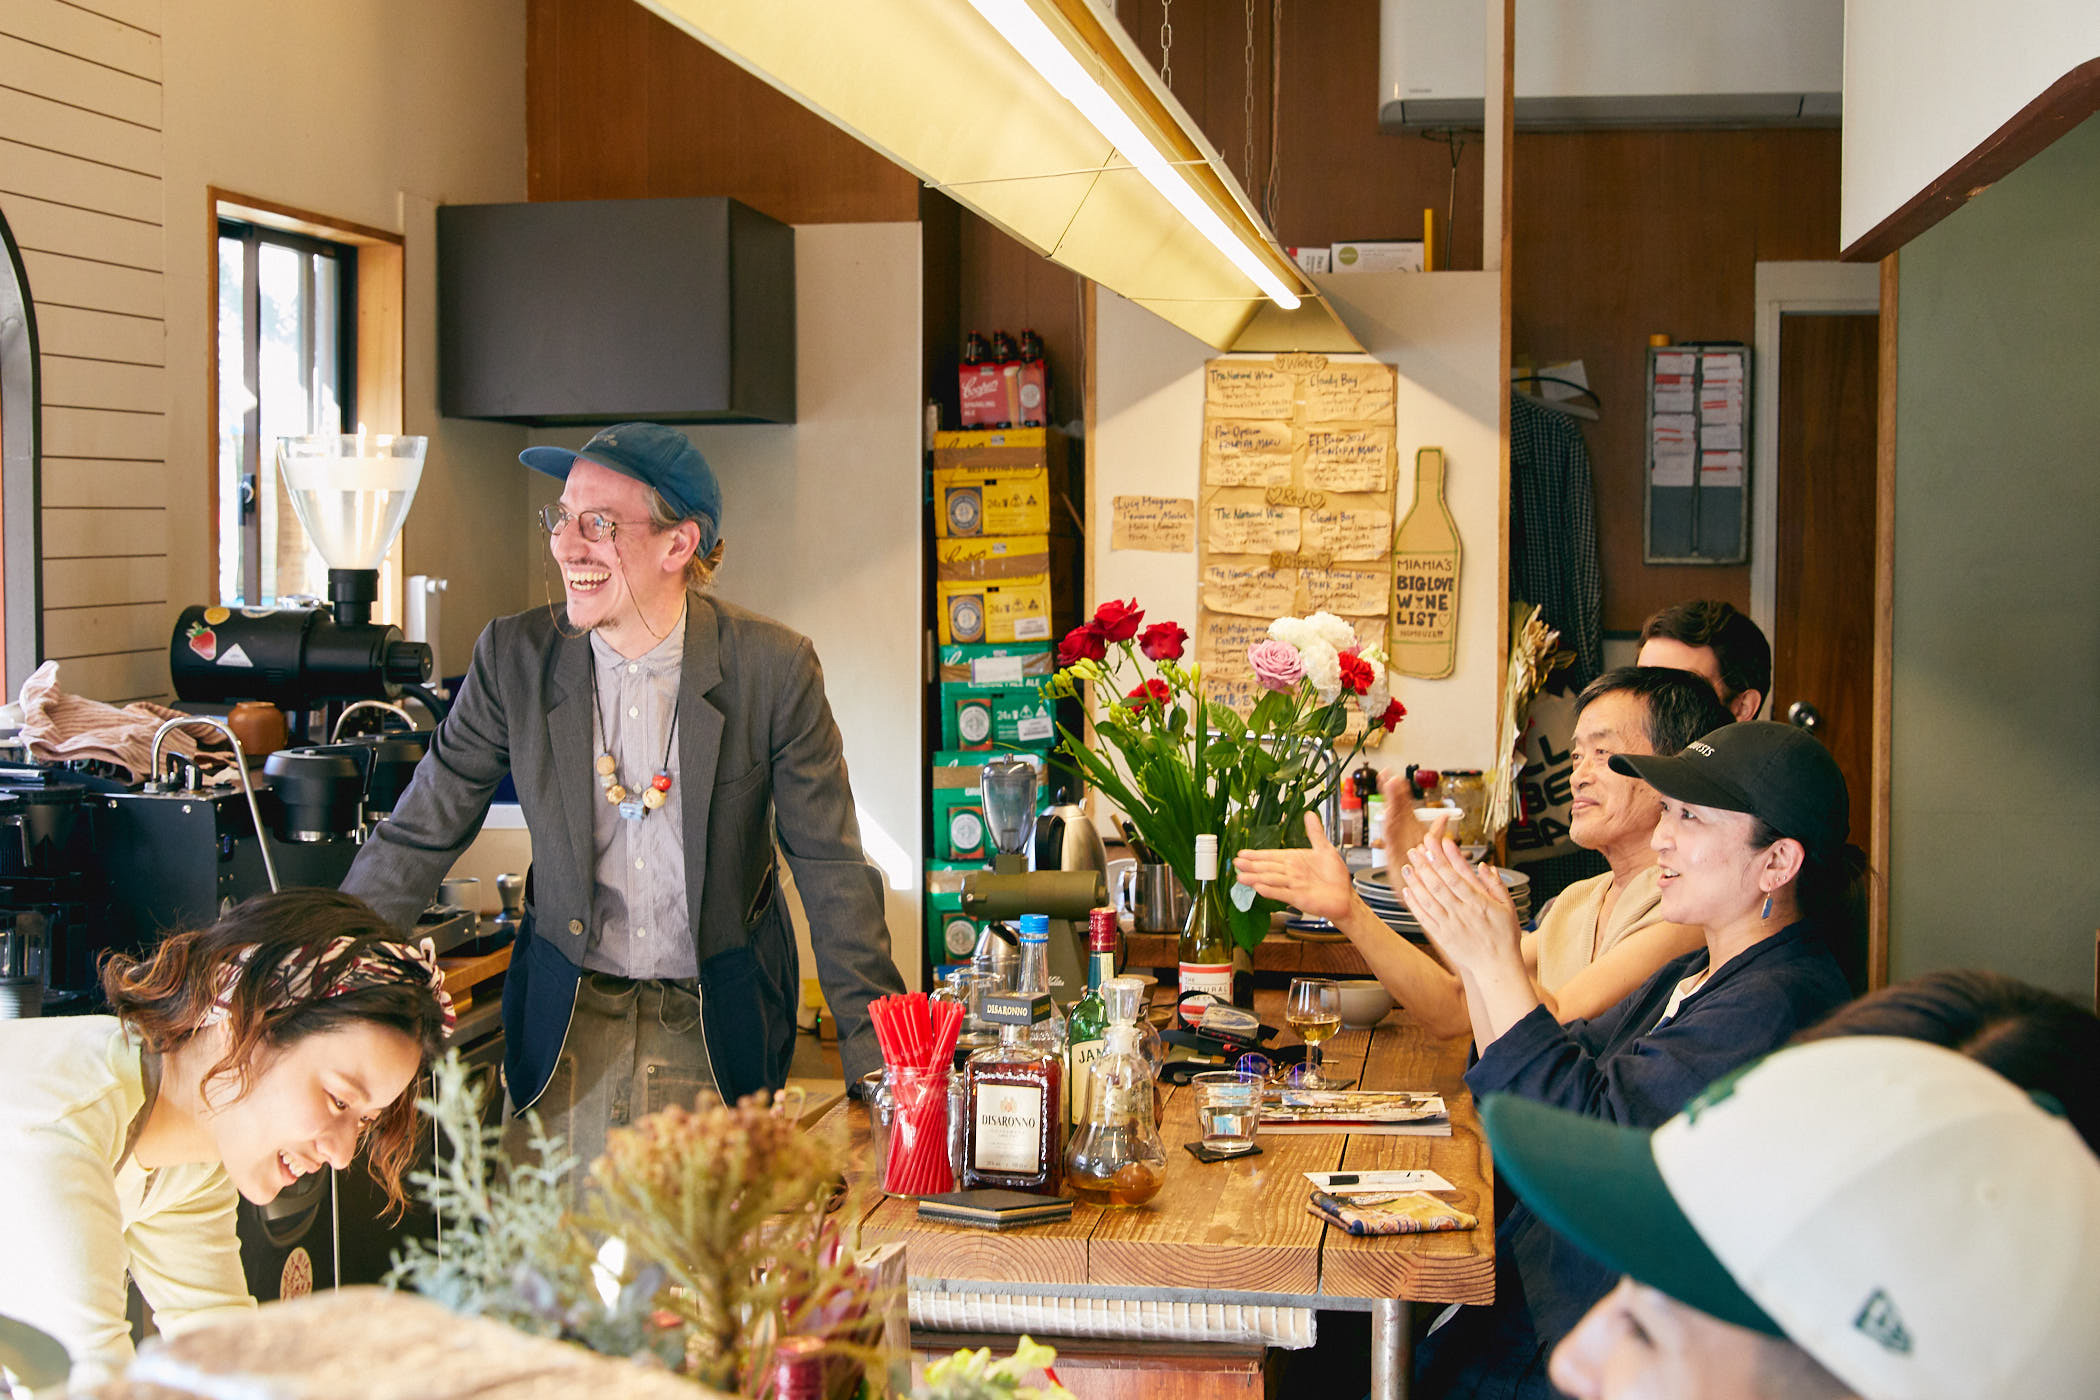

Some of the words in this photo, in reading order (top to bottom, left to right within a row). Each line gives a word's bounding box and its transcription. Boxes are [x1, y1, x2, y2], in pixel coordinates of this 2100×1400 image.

[1284, 491, 1307, 504] Red
[1397, 575, 1426, 591] BIG
[1397, 612, 1437, 628] LIST
[987, 1004, 1028, 1017] DISARONNO
[981, 1114, 1036, 1129] DISARONNO
